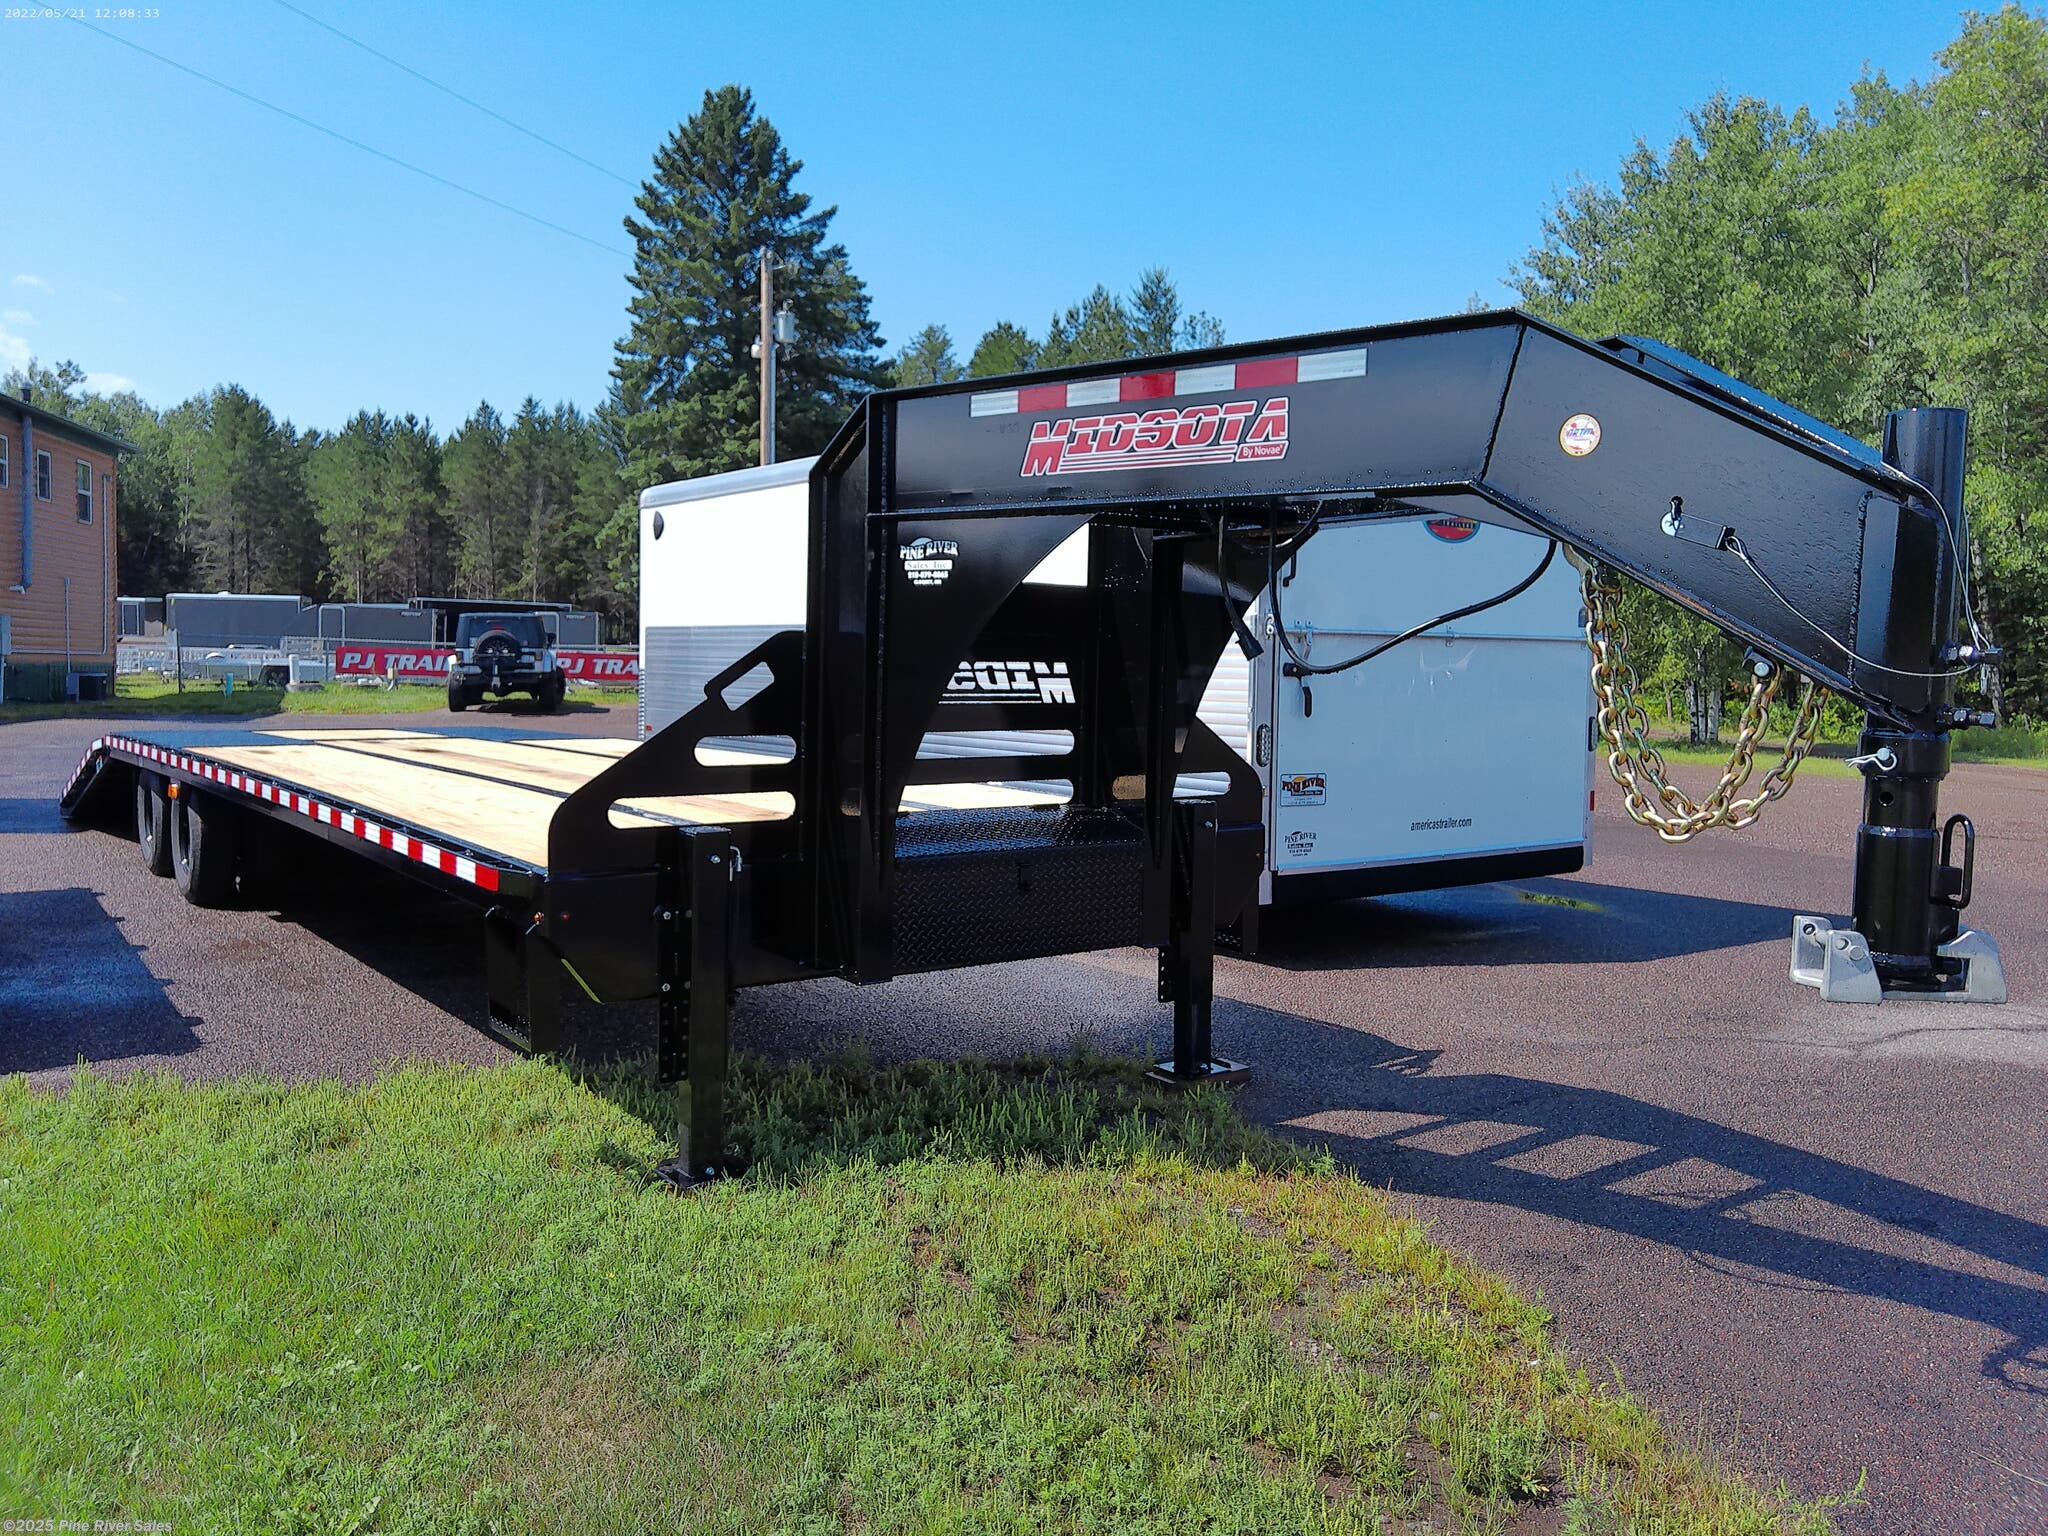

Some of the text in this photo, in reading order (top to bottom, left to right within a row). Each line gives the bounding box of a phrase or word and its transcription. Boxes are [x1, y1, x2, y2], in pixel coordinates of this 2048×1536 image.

[1021, 397, 1289, 477] MIDSOTA
[1243, 446, 1253, 458] By
[899, 540, 959, 560] PINE RIVER
[907, 561, 929, 569] Sales
[342, 652, 449, 672] PJ TRAI
[556, 657, 639, 675] PJ TRA
[1301, 776, 1325, 791] RIVER
[1410, 817, 1472, 831] americastrailer.com
[1284, 832, 1317, 843] PINE RIVER
